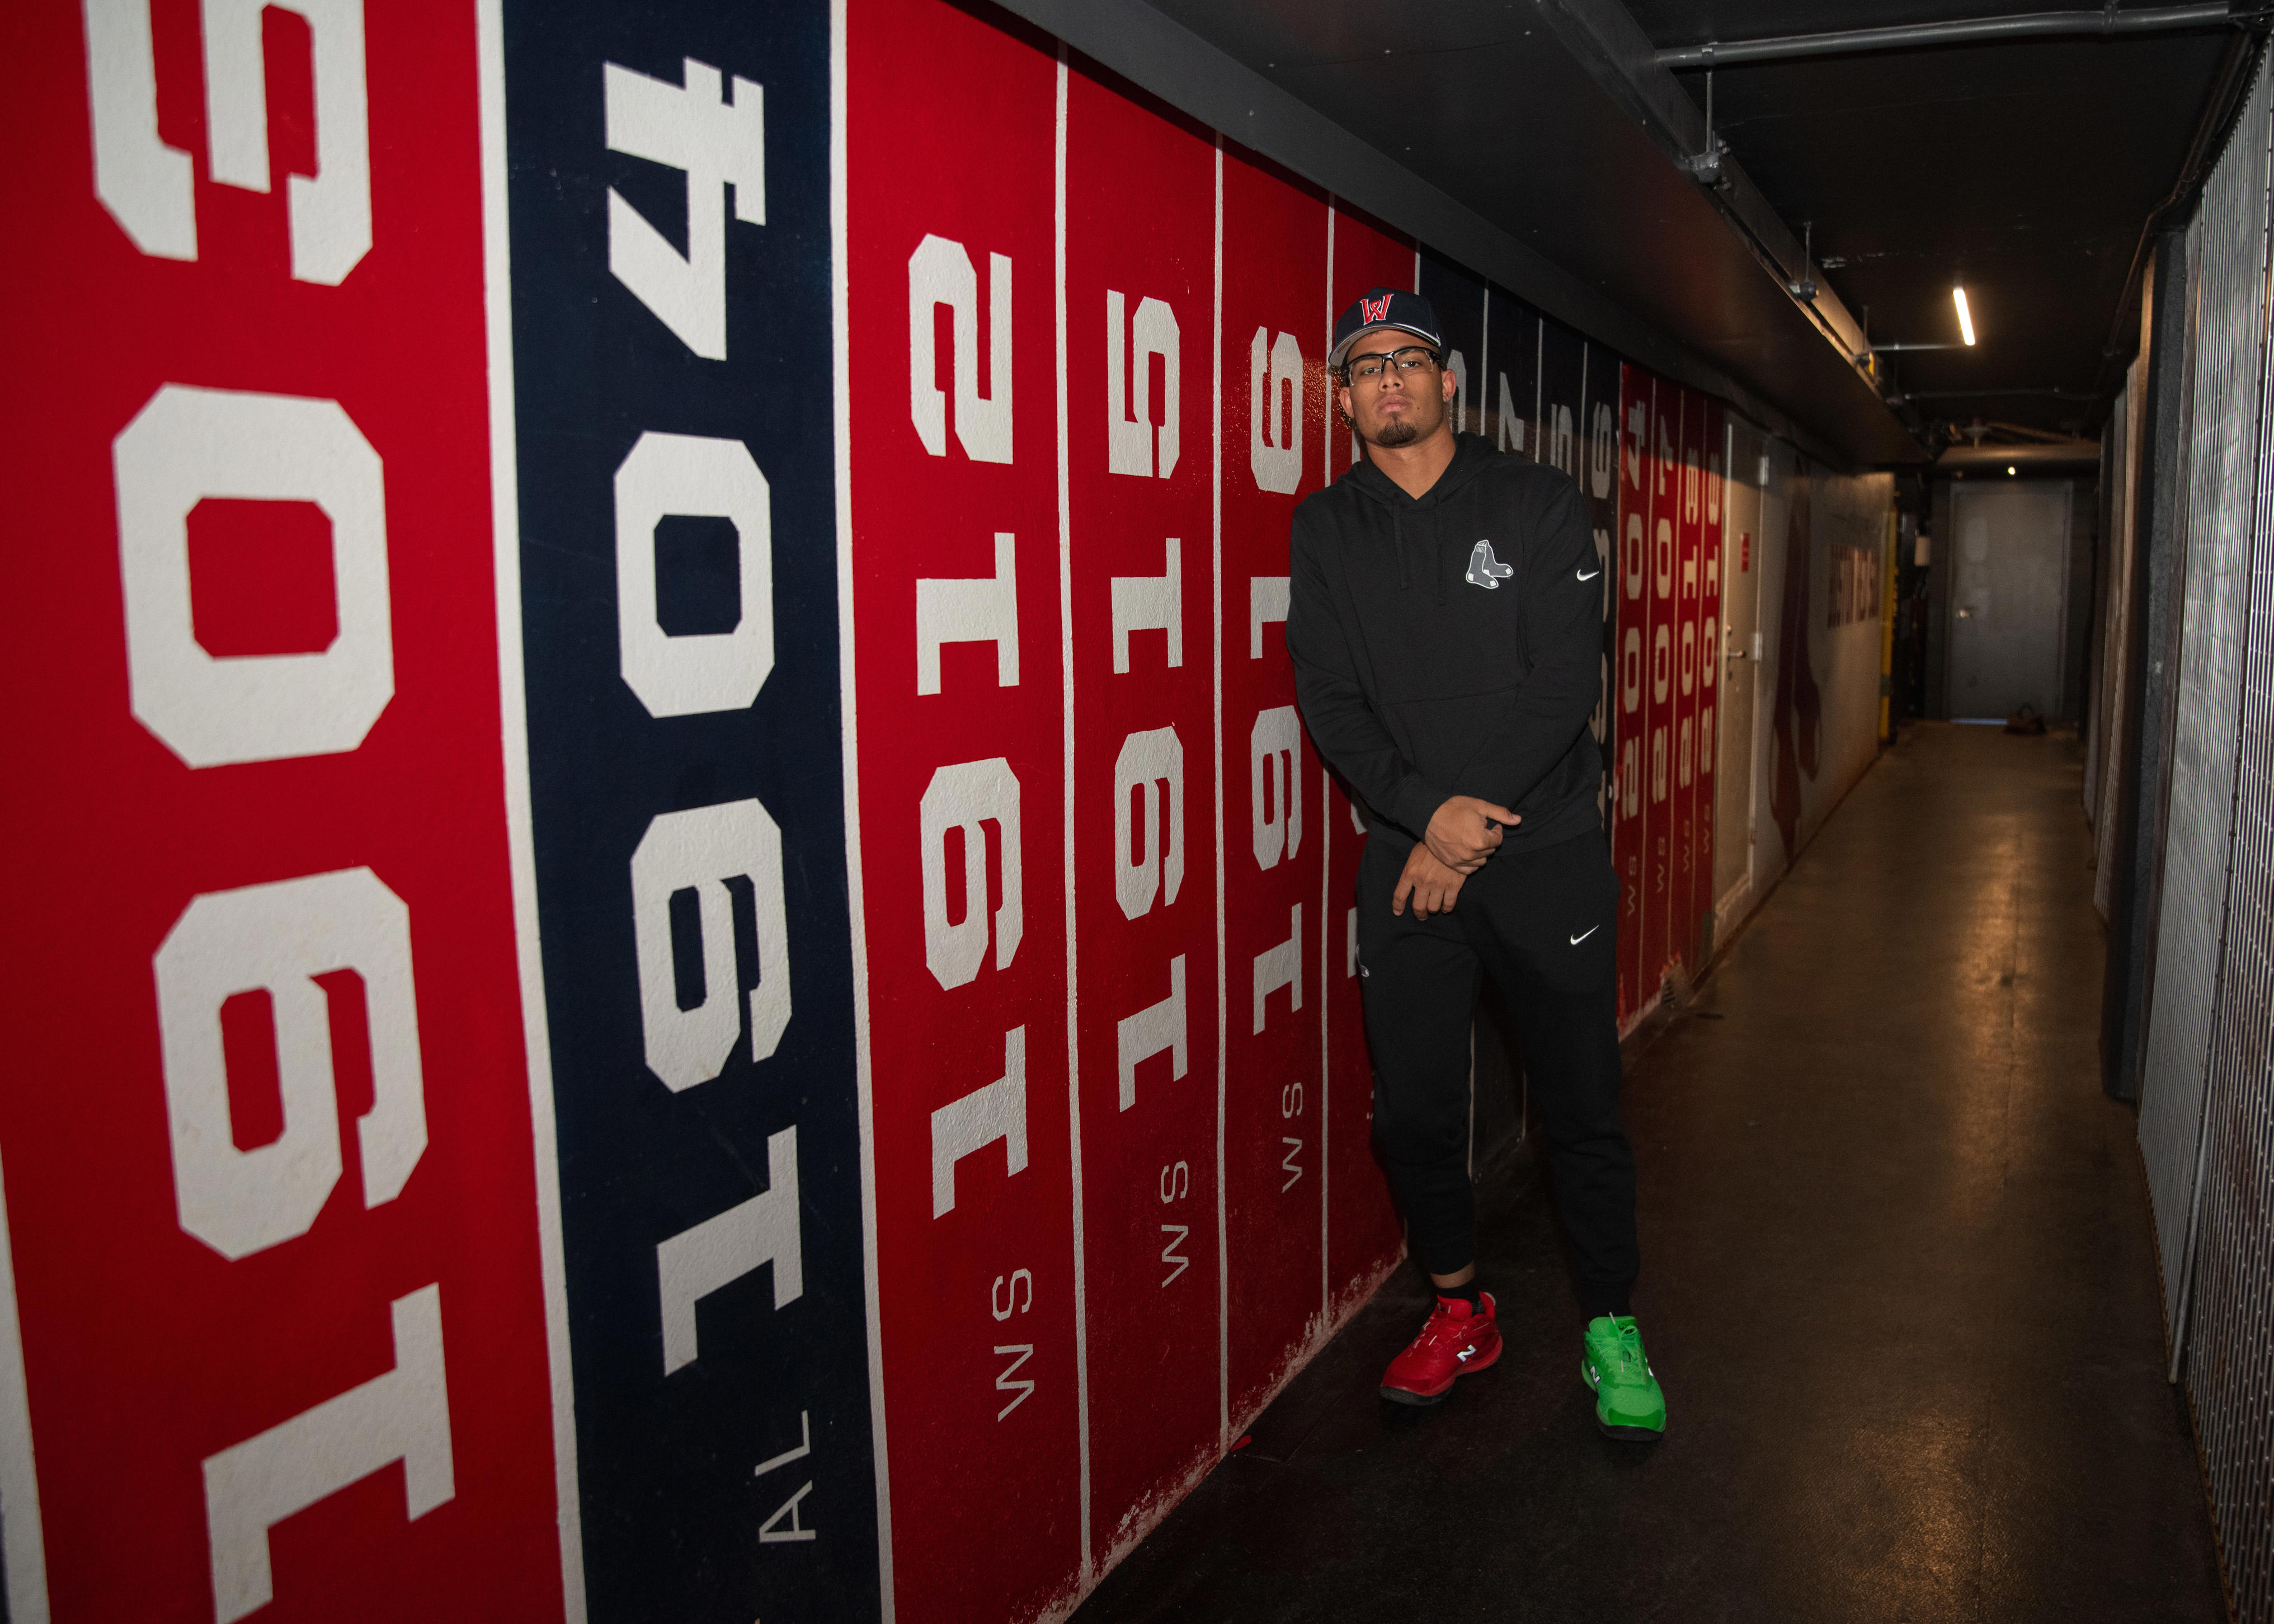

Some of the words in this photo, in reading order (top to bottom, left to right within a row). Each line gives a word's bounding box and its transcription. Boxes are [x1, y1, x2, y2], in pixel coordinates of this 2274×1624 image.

[1359, 293, 1394, 326] W
[604, 58, 802, 1375] 1904
[908, 233, 1028, 1220] 1912
[1107, 289, 1187, 1112] 1915
[1250, 326, 1304, 1035] 1916
[1622, 401, 1646, 821] 2004
[1652, 415, 1674, 804] 2007
[1679, 448, 1699, 789] 2013
[1701, 454, 1720, 775] 2018
[83, 0, 454, 1624] 1903
[1627, 856, 1636, 917] WS
[1656, 837, 1665, 894] WS
[1161, 1161, 1189, 1288] WS
[1282, 1082, 1302, 1193] WS
[755, 1410, 816, 1542] AL
[992, 1268, 1034, 1422] WS
